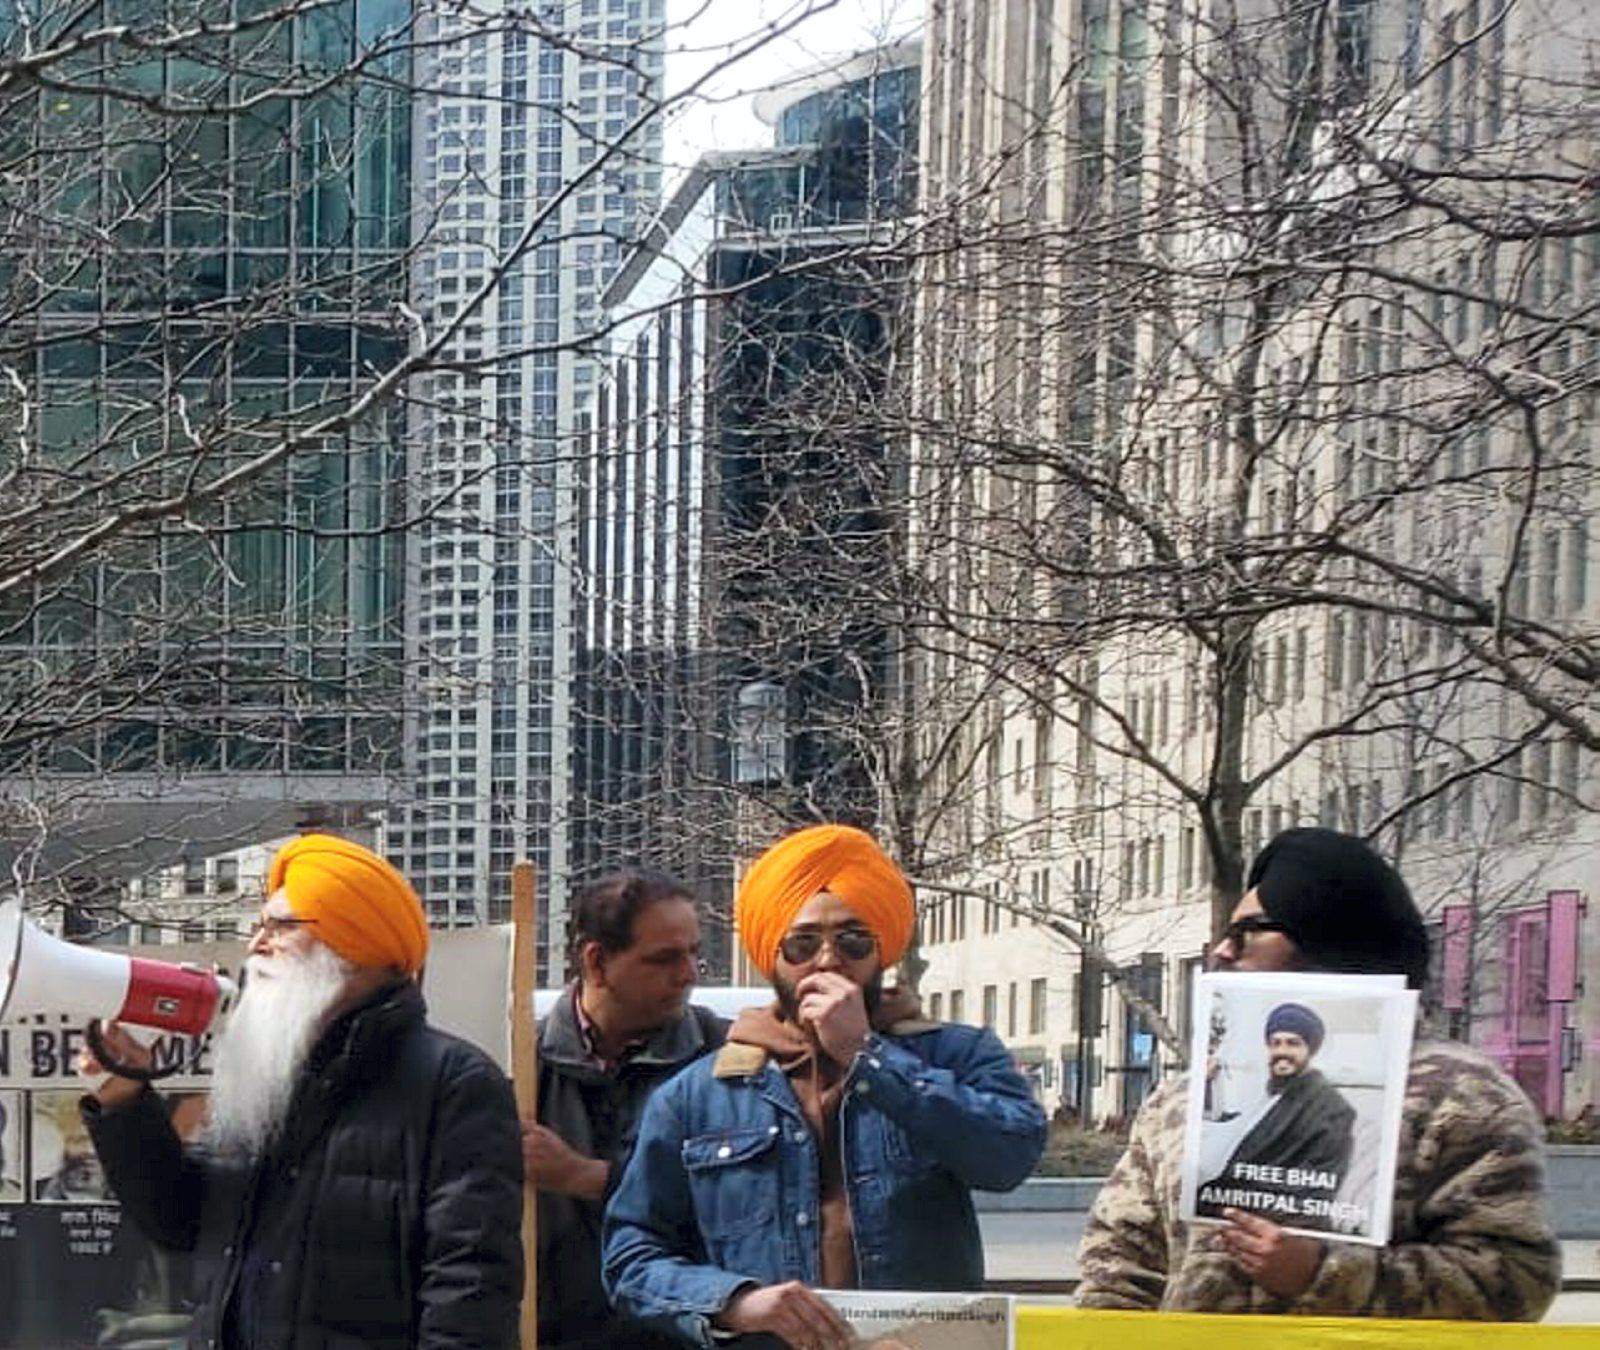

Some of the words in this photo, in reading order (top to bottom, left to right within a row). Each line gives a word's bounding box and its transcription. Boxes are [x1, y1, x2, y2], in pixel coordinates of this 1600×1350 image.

[1233, 1163, 1285, 1184] FREE
[1286, 1167, 1338, 1190] BHAI
[1200, 1185, 1301, 1214] AMRITPAL
[1301, 1198, 1368, 1221] SINGH
